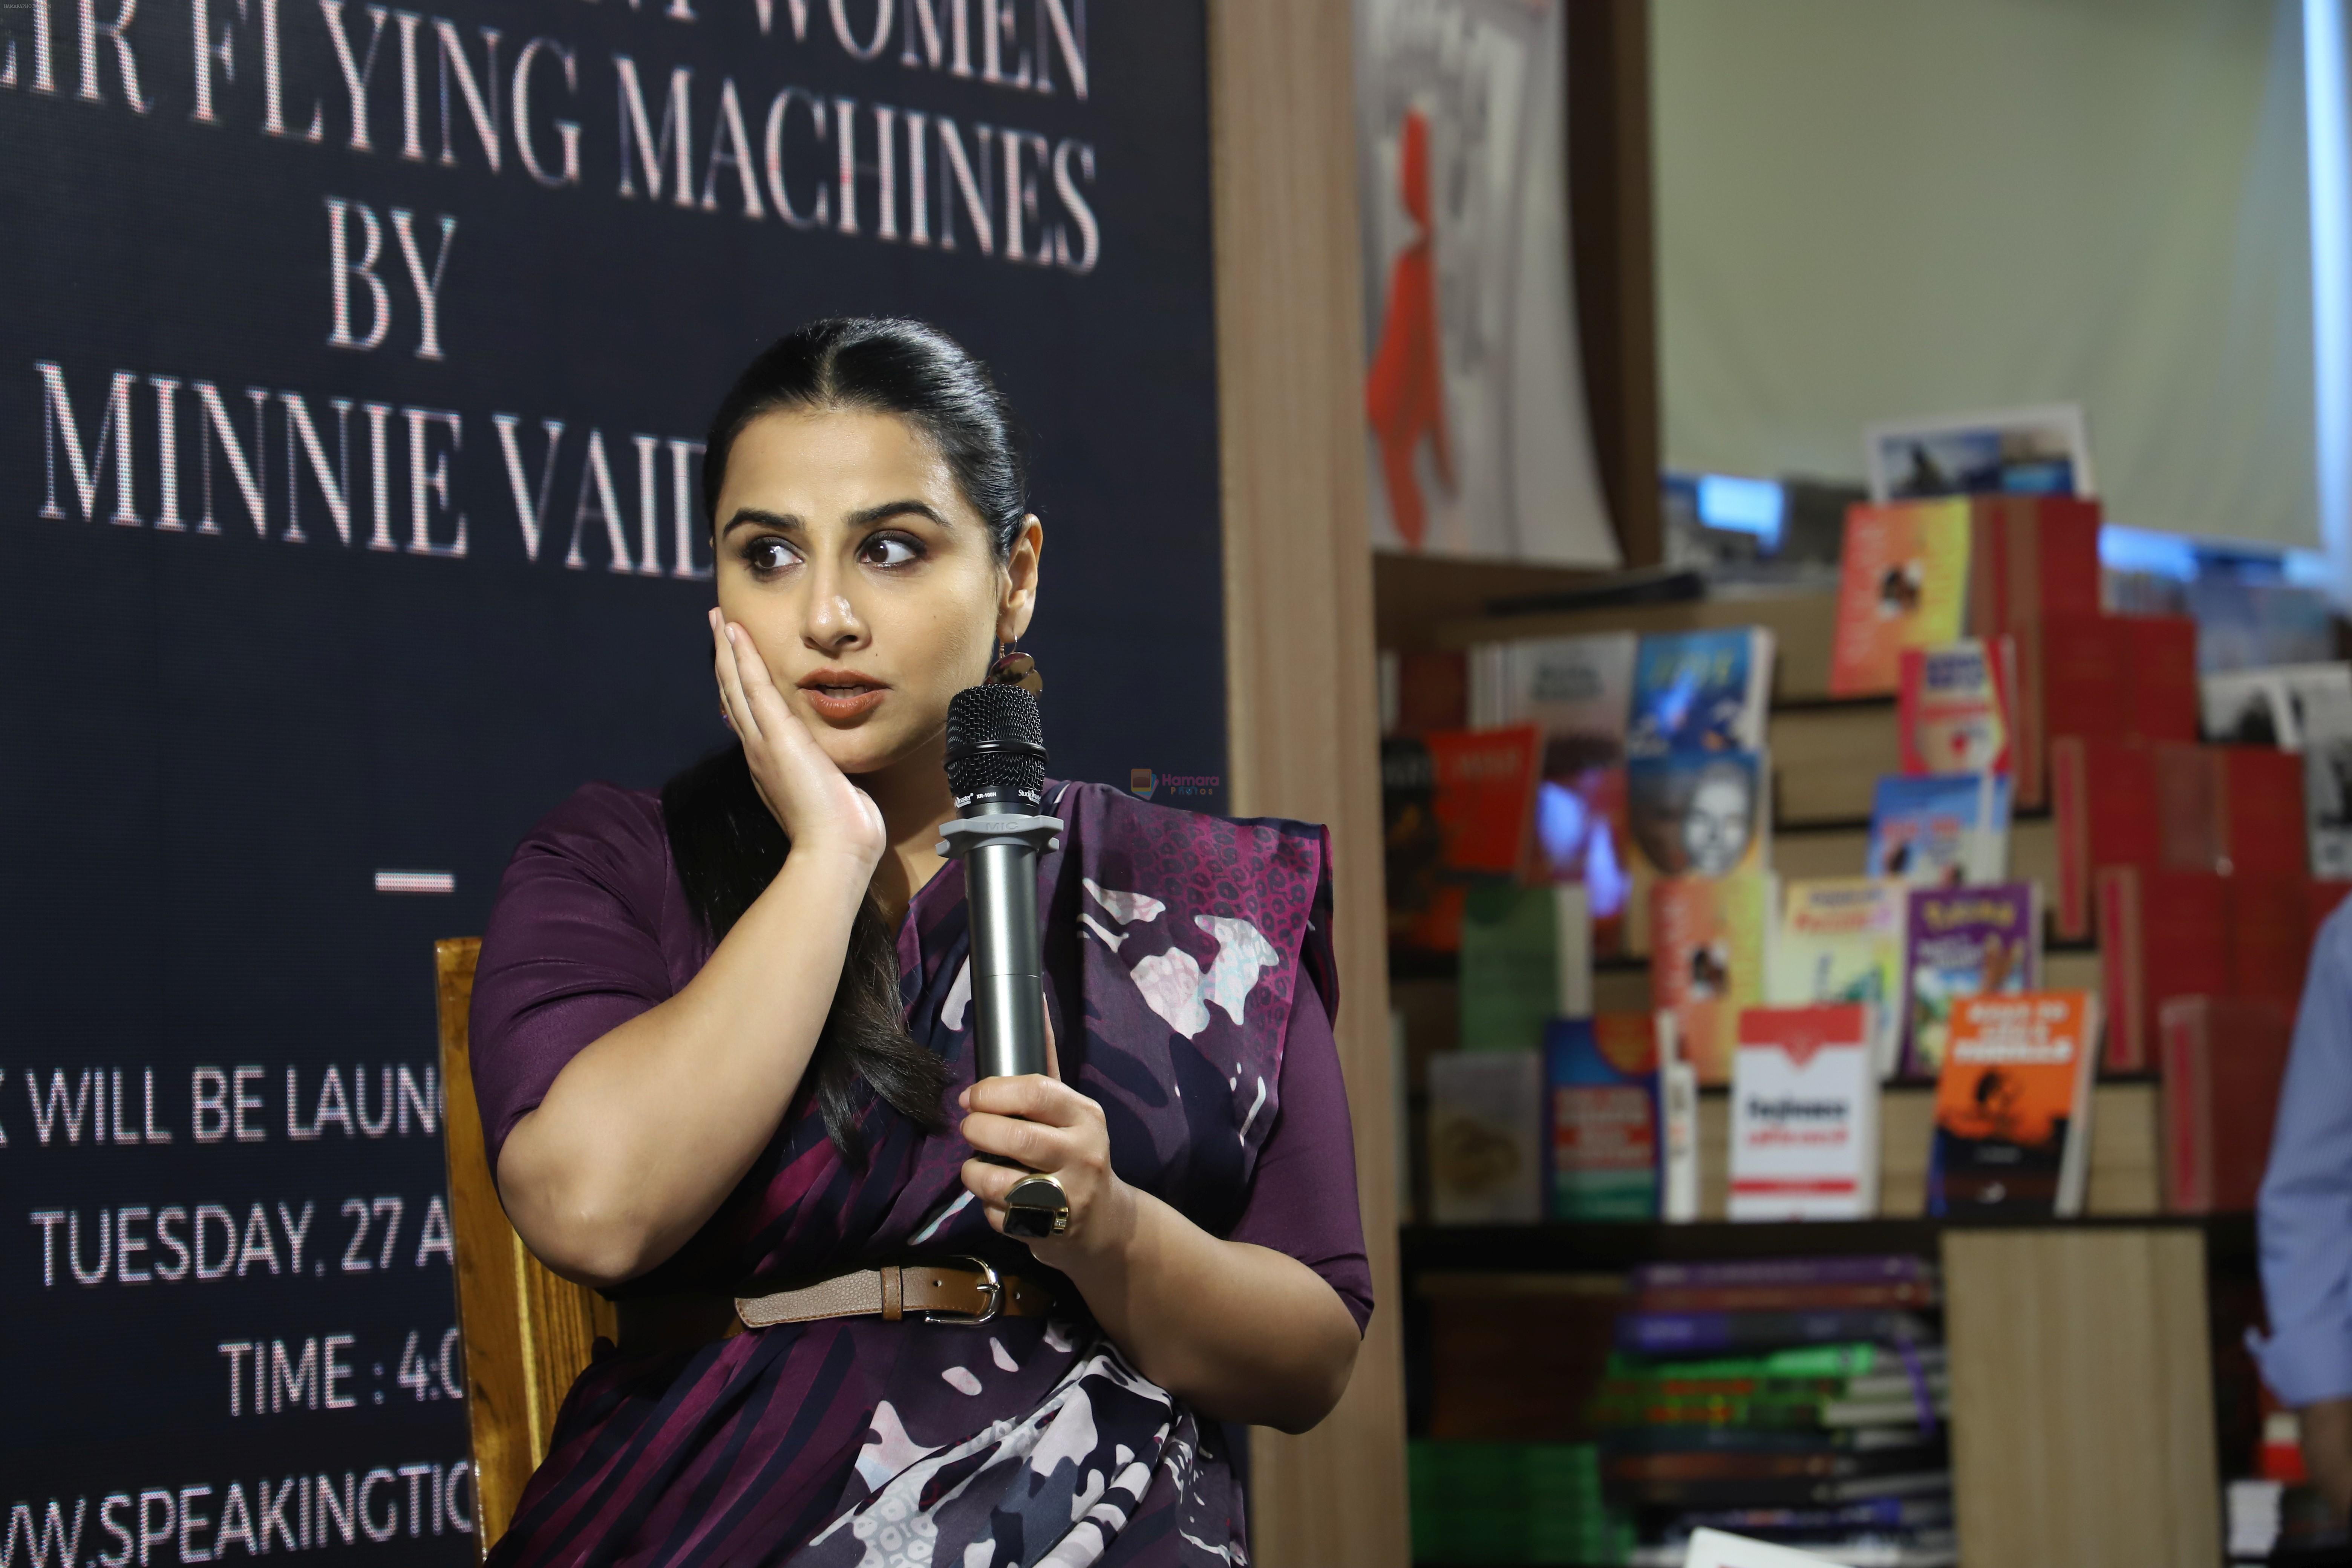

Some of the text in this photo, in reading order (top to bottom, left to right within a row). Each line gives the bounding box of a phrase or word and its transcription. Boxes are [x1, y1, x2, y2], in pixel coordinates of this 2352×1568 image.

[0, 0, 1099, 274] IR FLYING MACHINES
[325, 196, 457, 361] BY
[35, 360, 469, 559] MINNIE
[986, 822, 1018, 830] MIC
[26, 1067, 174, 1145] WILL
[191, 1065, 266, 1142] BE
[286, 1063, 443, 1139] LAUN
[341, 1196, 404, 1270] 27
[217, 1334, 358, 1416] TIME
